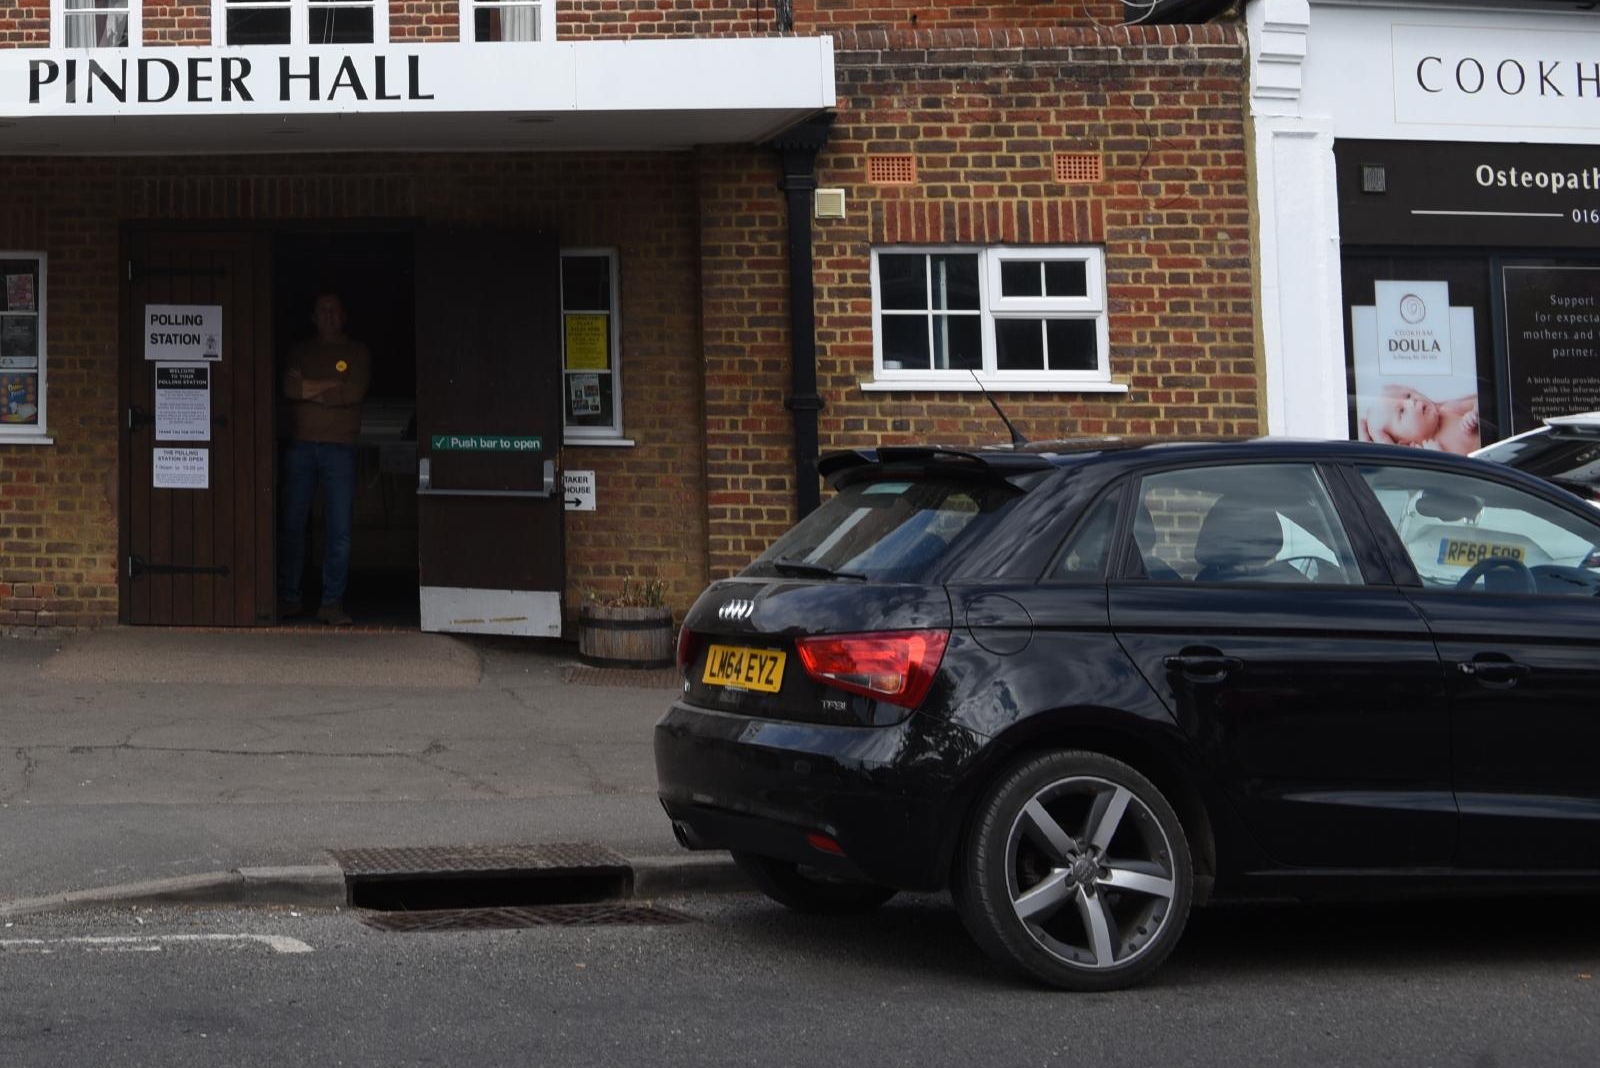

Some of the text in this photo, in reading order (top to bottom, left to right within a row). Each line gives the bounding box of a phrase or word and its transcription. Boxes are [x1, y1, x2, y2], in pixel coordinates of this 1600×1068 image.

[28, 54, 435, 105] PINDER HALL
[1416, 56, 1600, 99] COOKH
[1550, 294, 1595, 309] Support
[150, 314, 203, 326] POLLING
[1535, 311, 1552, 323] for
[150, 333, 201, 345] STATION
[1523, 328, 1569, 341] mothers
[1573, 328, 1594, 341] and
[1387, 338, 1442, 353] DOULA
[1552, 347, 1599, 360] partner.
[1534, 376, 1551, 385] birth
[1552, 376, 1571, 385] doula
[1543, 385, 1559, 394] with
[1560, 385, 1571, 394] the
[1545, 395, 1571, 405] support
[450, 437, 541, 451] Push bar to open
[1447, 541, 1488, 563] RF68
[708, 649, 779, 686] LM64 EYZ
